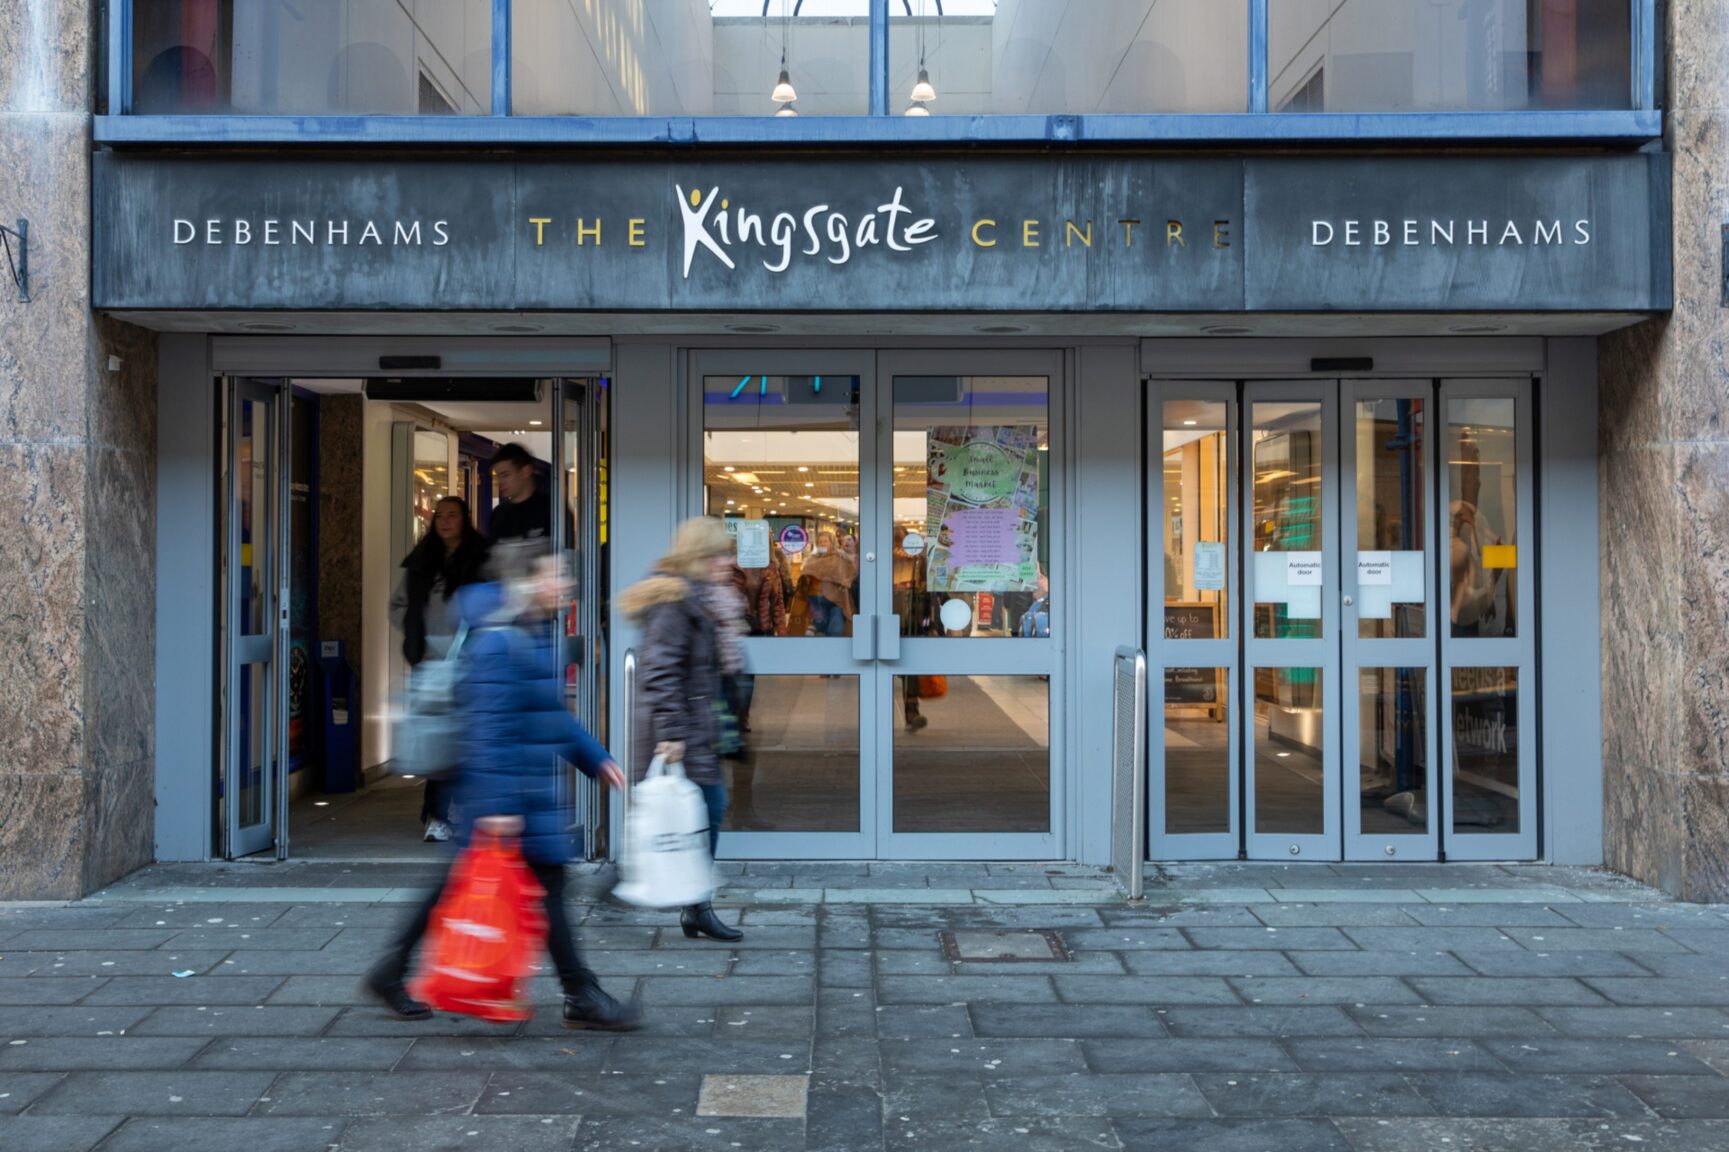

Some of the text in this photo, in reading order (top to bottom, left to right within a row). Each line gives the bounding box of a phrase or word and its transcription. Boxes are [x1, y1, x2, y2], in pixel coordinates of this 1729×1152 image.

[173, 219, 449, 246] DEBENHAMS
[529, 184, 1231, 279] THE Kingsgate CENTRE
[1312, 220, 1590, 246] DEBENHAMS
[963, 467, 999, 477] Business
[1189, 612, 1199, 624] to
[1453, 705, 1508, 754] etwork
